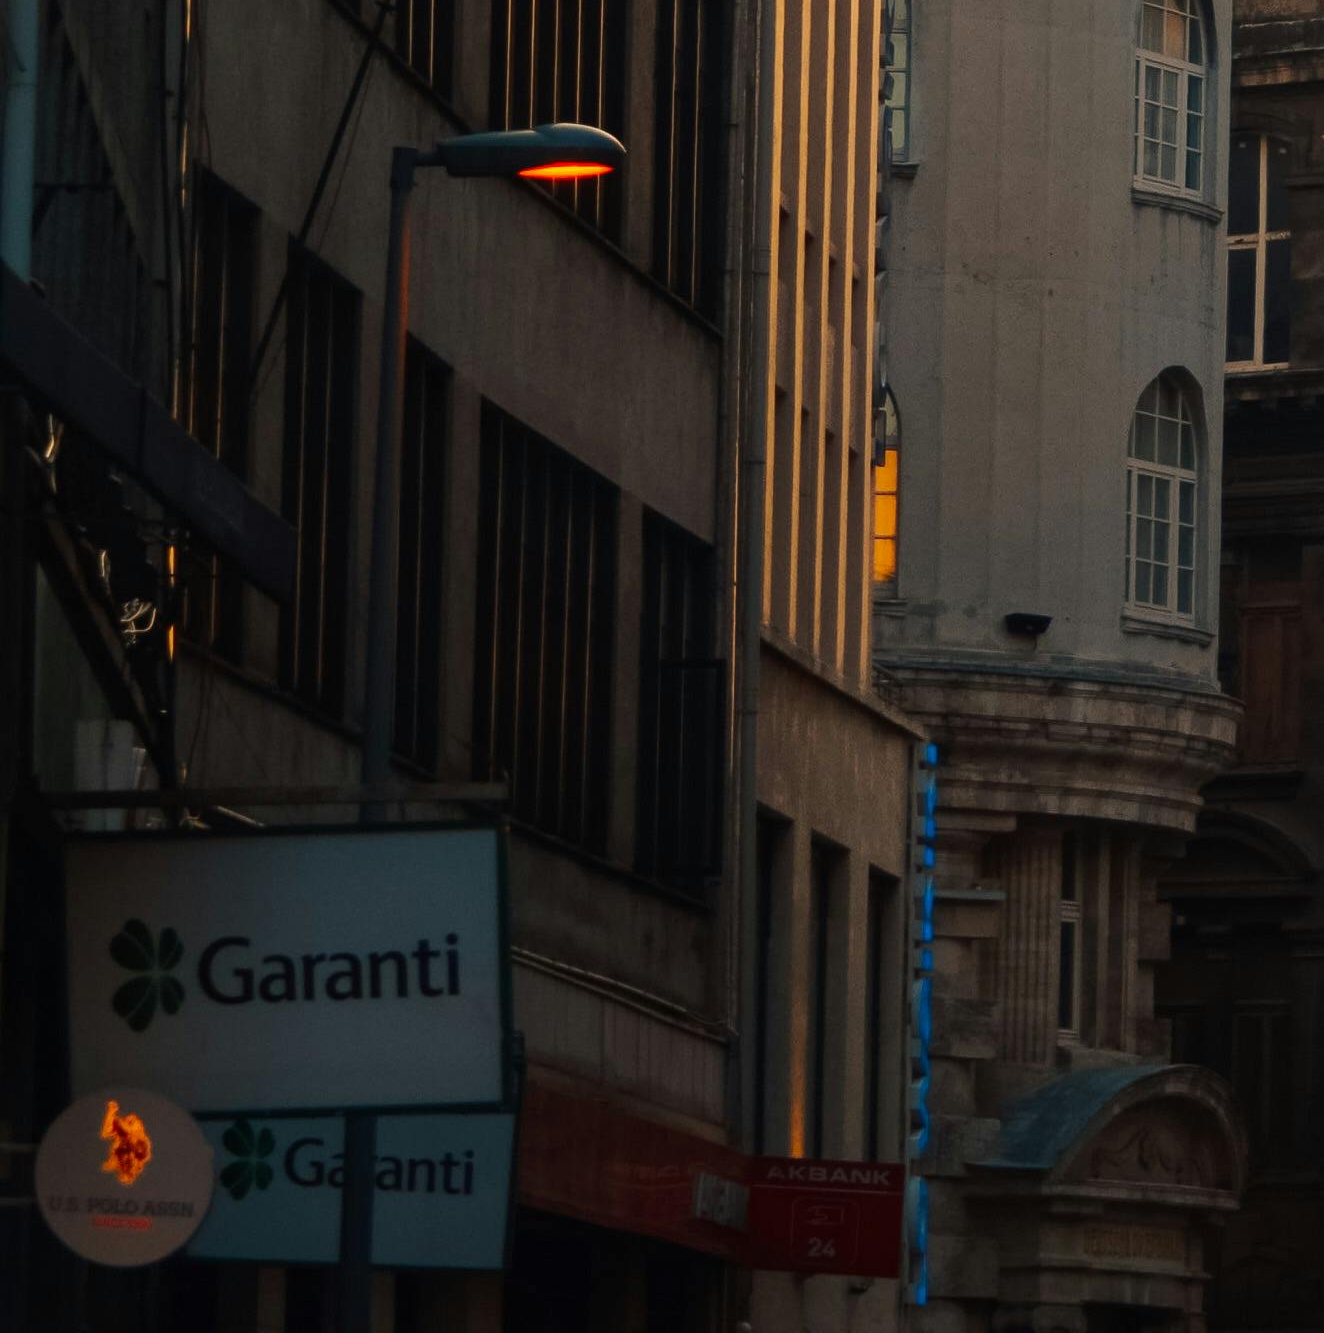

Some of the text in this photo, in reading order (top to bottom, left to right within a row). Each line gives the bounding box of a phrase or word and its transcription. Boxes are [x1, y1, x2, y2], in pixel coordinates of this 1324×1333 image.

[198, 932, 460, 1005] Garanti
[284, 1136, 474, 1196] Gaanti
[766, 1165, 891, 1186] AKBANK
[807, 1236, 836, 1258] 24
